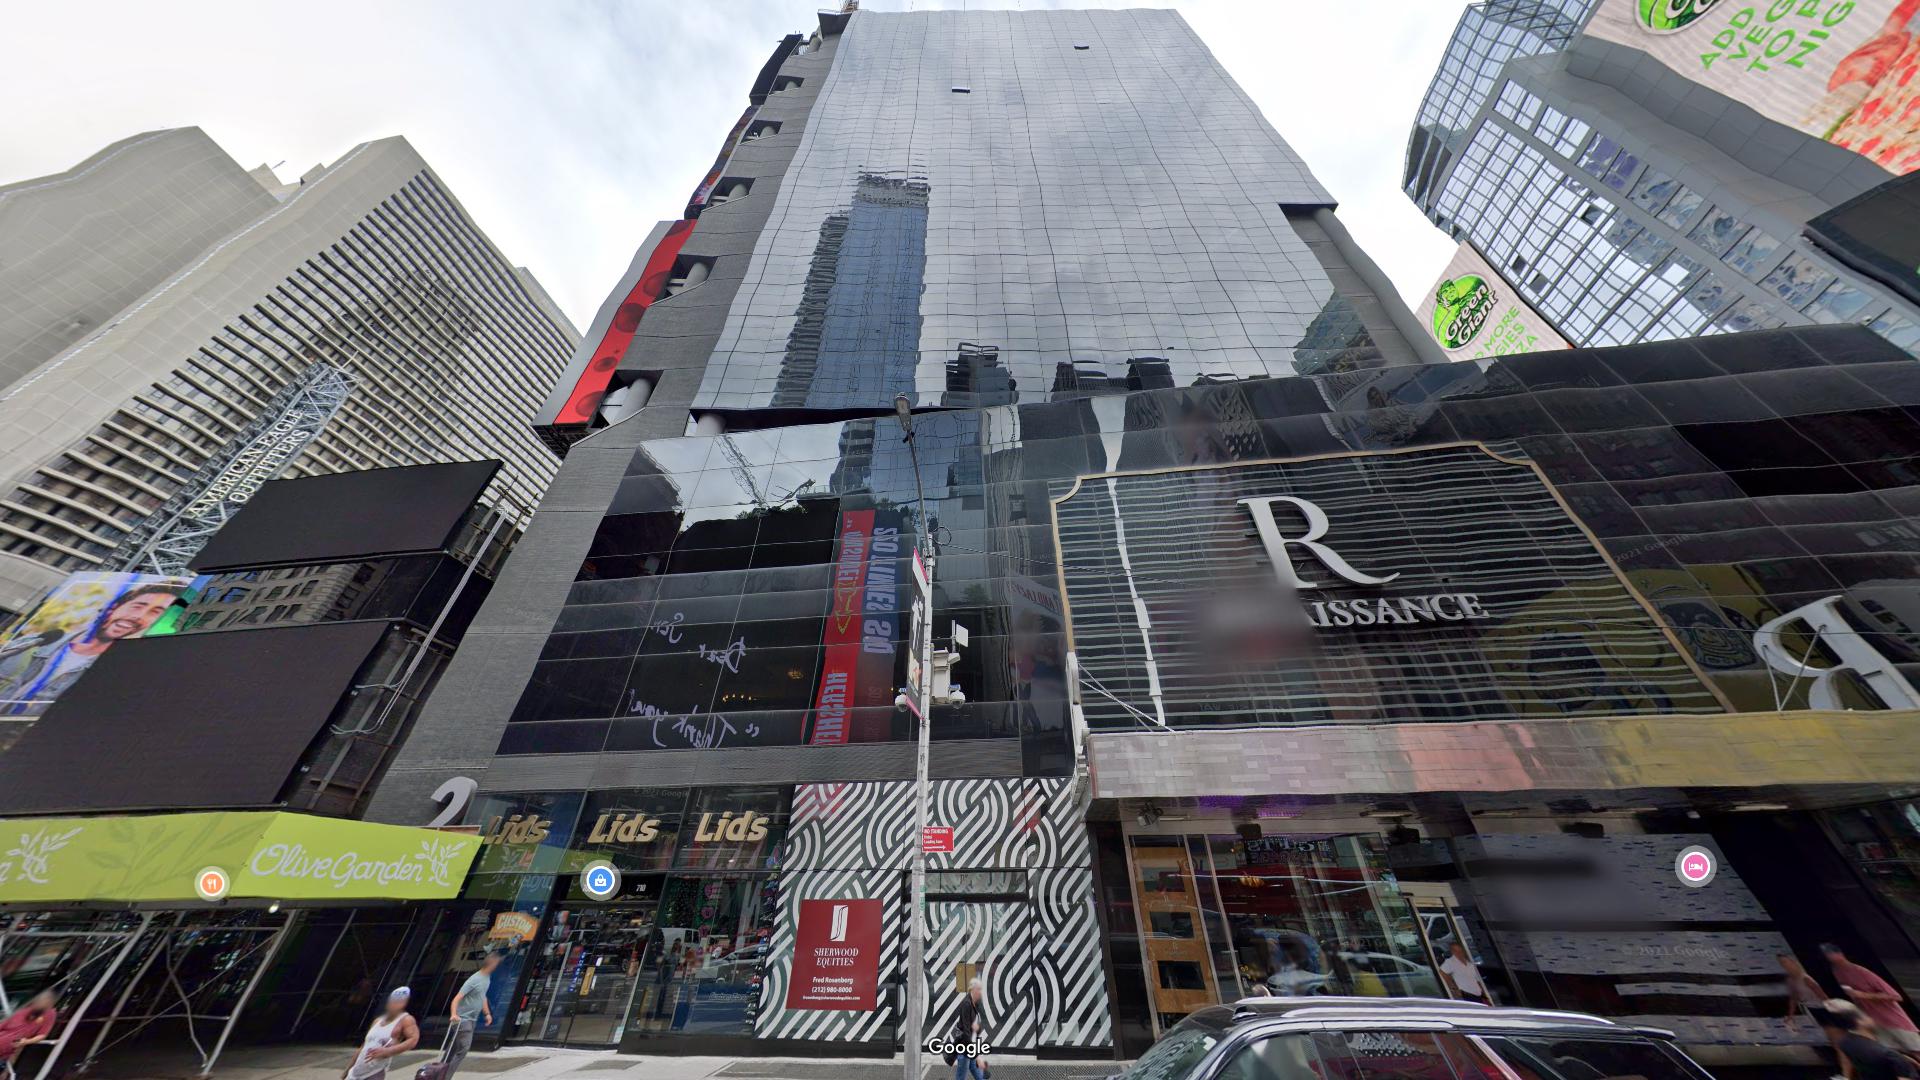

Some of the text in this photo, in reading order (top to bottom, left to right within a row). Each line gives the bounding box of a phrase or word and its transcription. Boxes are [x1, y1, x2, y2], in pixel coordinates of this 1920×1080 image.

[1699, 7, 1755, 70] ADD
[1746, 28, 1796, 72] TO
[1784, 0, 1857, 69] NIG
[1445, 284, 1489, 341] Green
[1457, 289, 1499, 344] Giant
[1483, 305, 1520, 351] MORE
[1494, 322, 1525, 357] GIES
[187, 408, 303, 519] AMERICAN EAGLE
[228, 429, 310, 503] OUTFITTERS
[1306, 592, 1490, 628] ISSANCE
[484, 814, 552, 845] Lids
[587, 812, 661, 844] Lids
[694, 810, 769, 842] Lids
[251, 842, 424, 889] Olive Garden
[497, 914, 532, 933] CUSTOM
[814, 948, 859, 957] SHERWOOD
[816, 957, 854, 968] EQUITIES
[811, 986, 826, 994] (212)
[825, 976, 854, 986] Rosenberg
